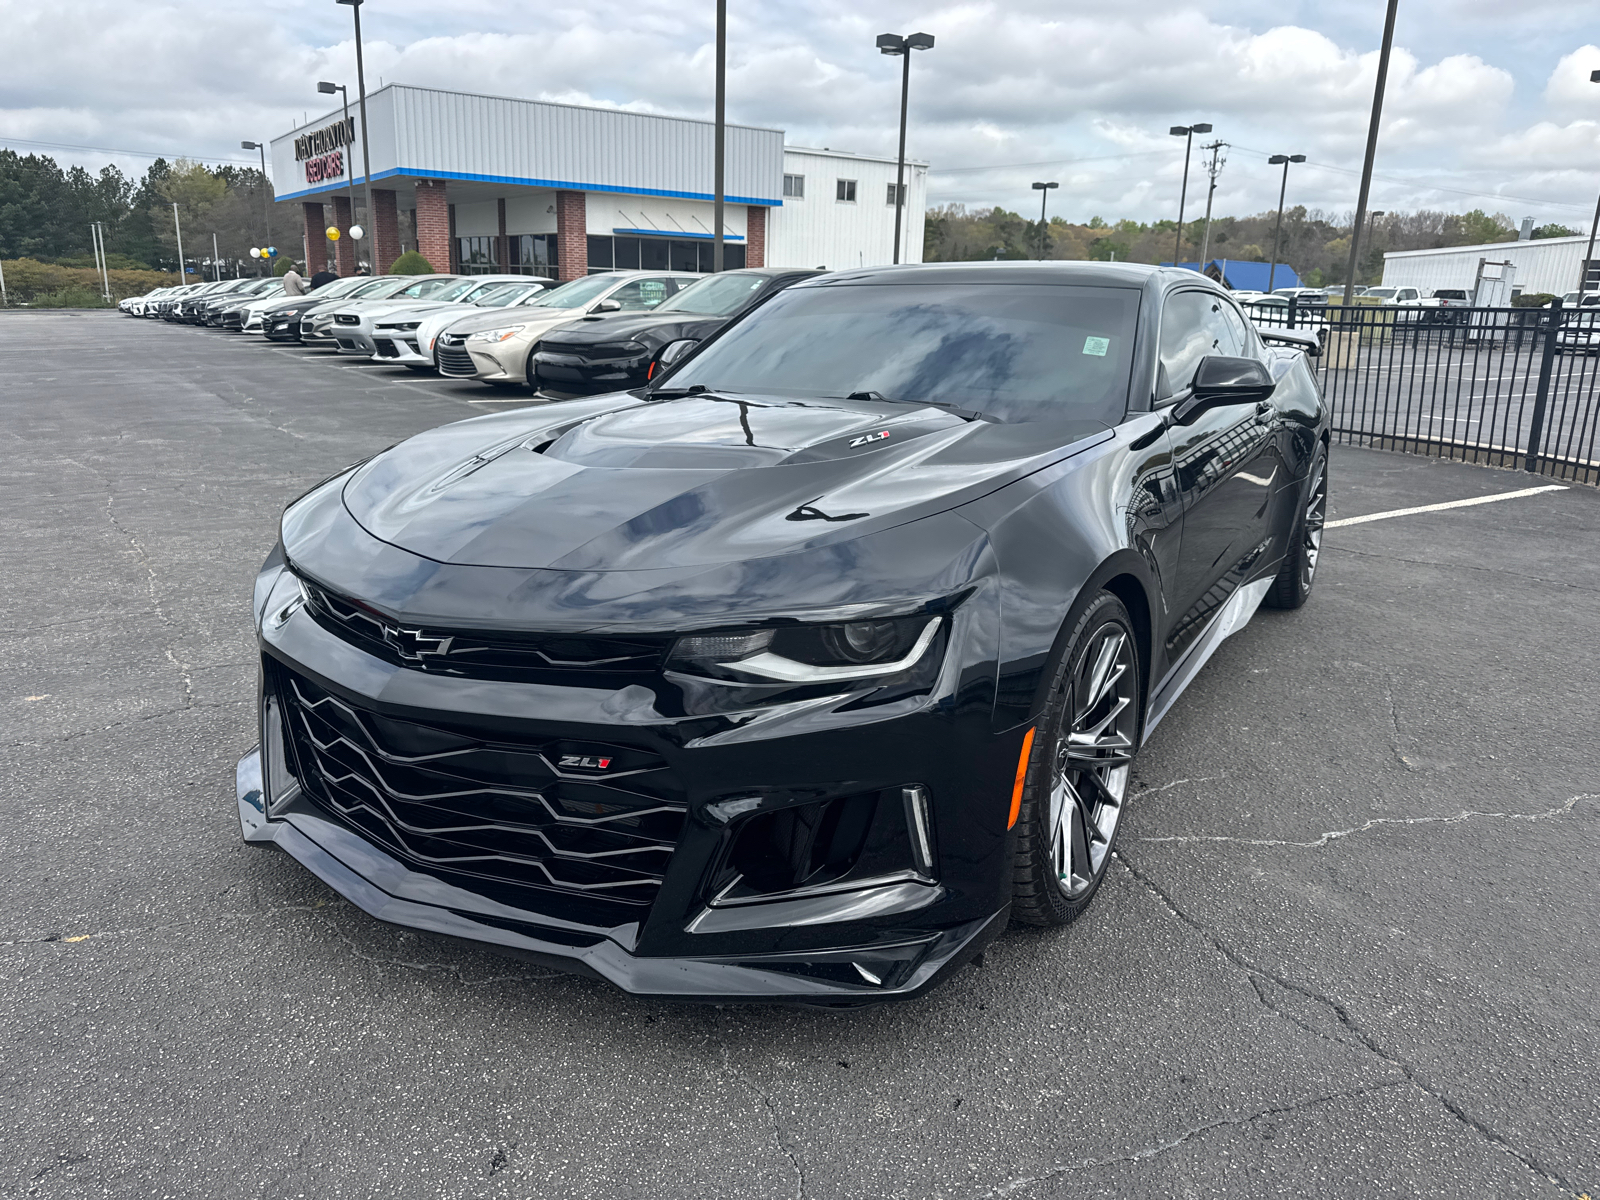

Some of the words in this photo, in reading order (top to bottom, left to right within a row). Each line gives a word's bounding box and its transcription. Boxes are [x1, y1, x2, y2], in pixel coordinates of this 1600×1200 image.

[305, 157, 323, 183] USED
[322, 151, 343, 178] CARS
[849, 430, 890, 448] ZL1
[558, 755, 610, 769] ZL1
